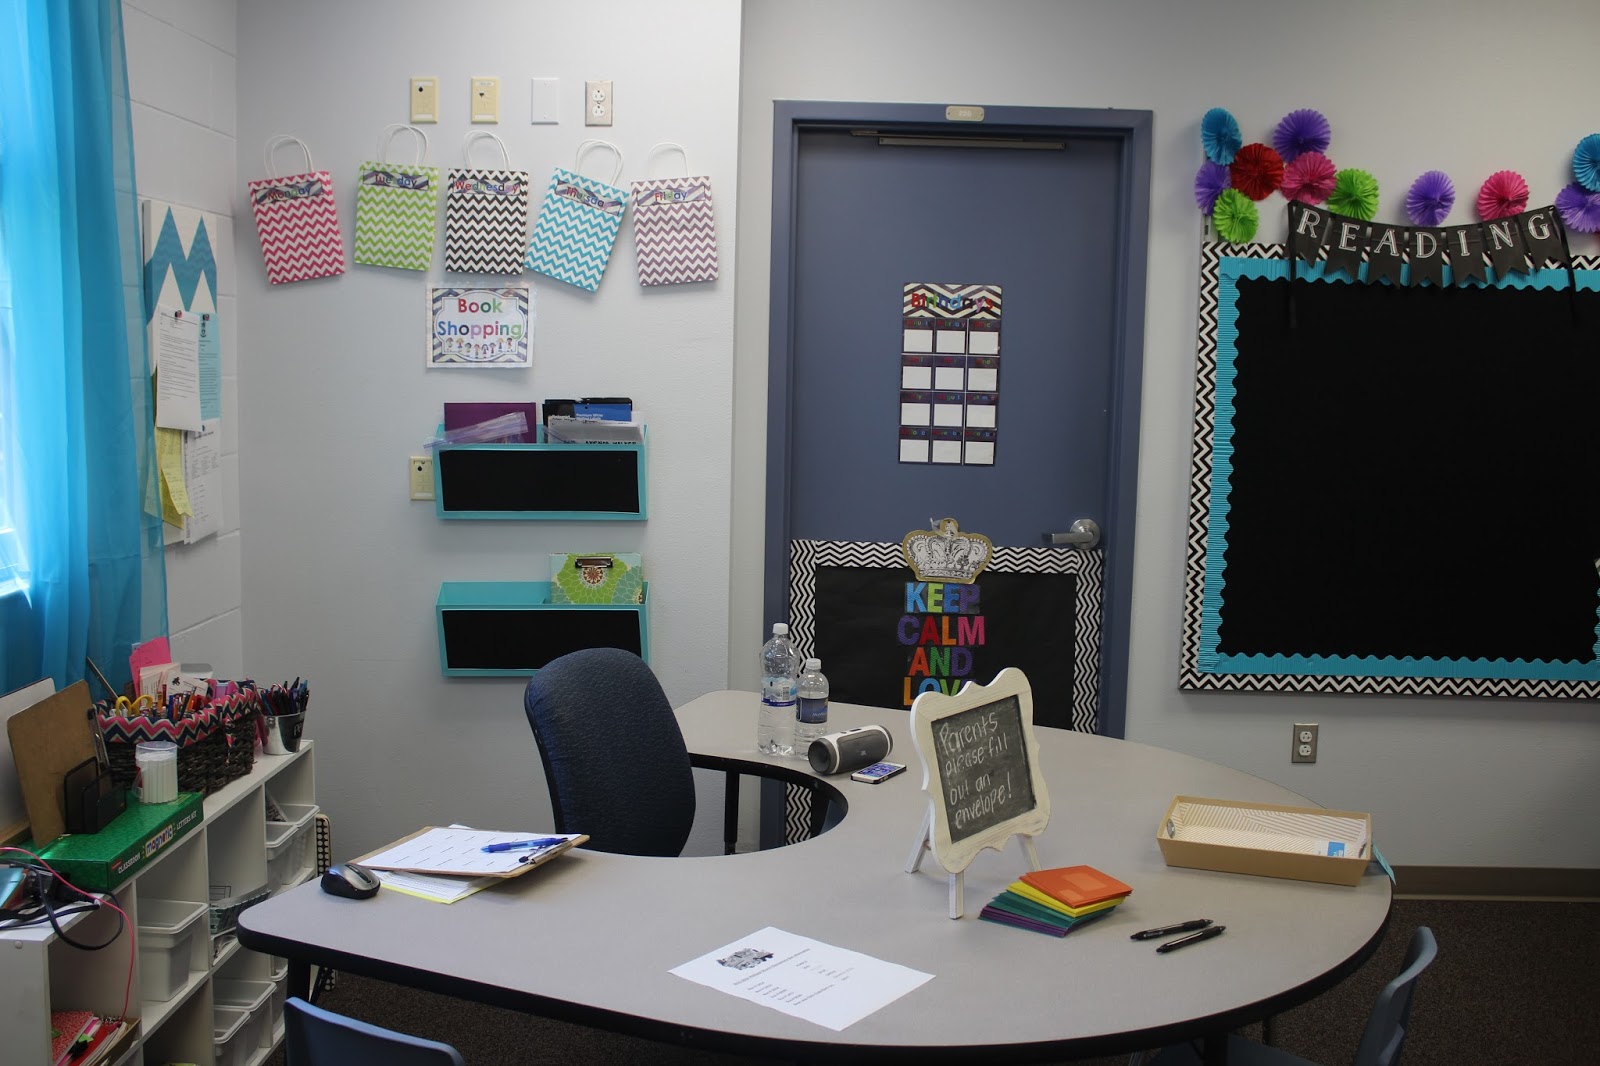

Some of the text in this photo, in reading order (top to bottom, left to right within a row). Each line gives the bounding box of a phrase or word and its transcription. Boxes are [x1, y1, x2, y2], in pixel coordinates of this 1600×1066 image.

[267, 185, 311, 201] Monday
[374, 174, 418, 189] Tuesday
[455, 180, 521, 195] Wednesday
[653, 191, 688, 202] Friday
[565, 186, 612, 209] Thursday
[1296, 207, 1551, 259] READING
[457, 298, 503, 313] Book
[911, 292, 994, 313] Birthdays
[437, 320, 523, 340] Shopping
[906, 582, 981, 614] KEEP
[897, 615, 985, 646] CALM
[908, 646, 973, 677] AND
[903, 677, 976, 706] LOV
[938, 712, 998, 756] Parents
[945, 732, 1008, 779] please fill
[949, 773, 991, 806] out an
[955, 771, 1012, 829] envelope!
[118, 852, 141, 874] CLASSROOM
[146, 826, 173, 854] magnetic
